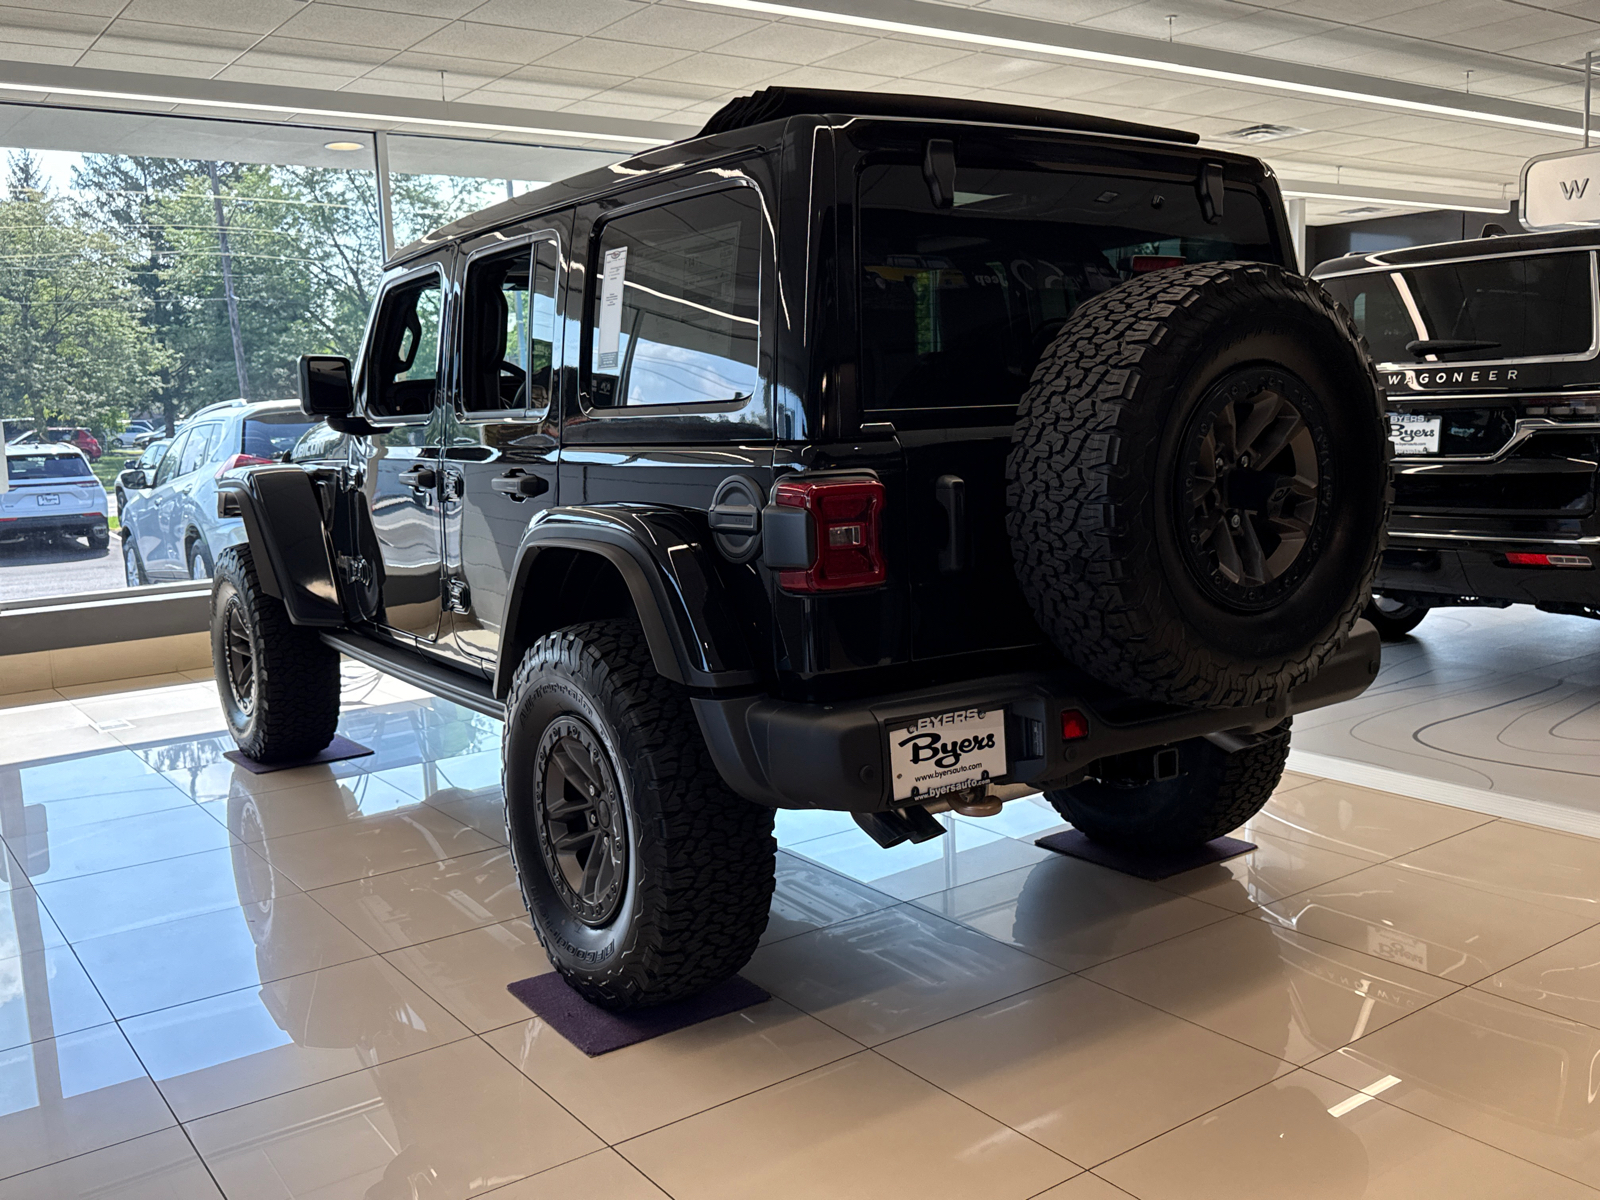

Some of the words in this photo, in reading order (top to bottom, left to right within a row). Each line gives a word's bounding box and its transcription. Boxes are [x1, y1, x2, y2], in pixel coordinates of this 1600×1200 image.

[1560, 178, 1600, 200] W
[1388, 369, 1518, 385] WAGONEER
[1390, 415, 1425, 423] BYERS
[917, 709, 978, 731] BYERS
[898, 732, 996, 769] Byers
[914, 762, 983, 783] www.byersauto.com
[914, 777, 991, 802] www.byersauto.com
